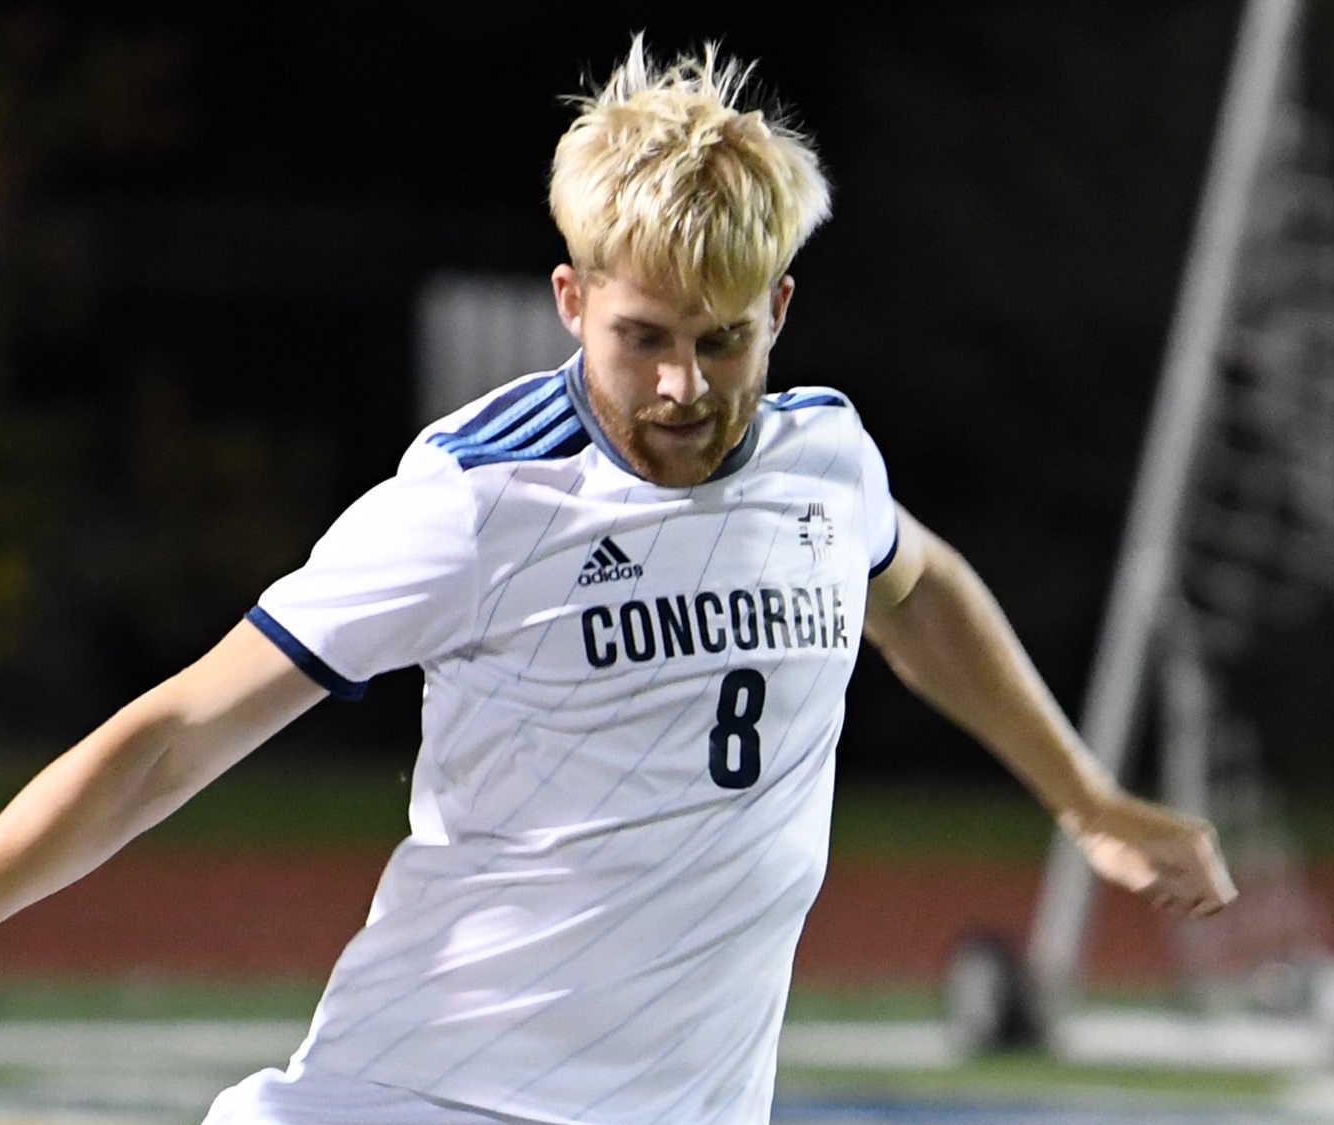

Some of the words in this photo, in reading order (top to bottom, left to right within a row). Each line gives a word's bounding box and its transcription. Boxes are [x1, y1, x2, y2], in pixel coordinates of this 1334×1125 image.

[577, 563, 644, 587] adidas
[581, 585, 849, 669] CONCORDIA
[708, 667, 767, 789] 8
